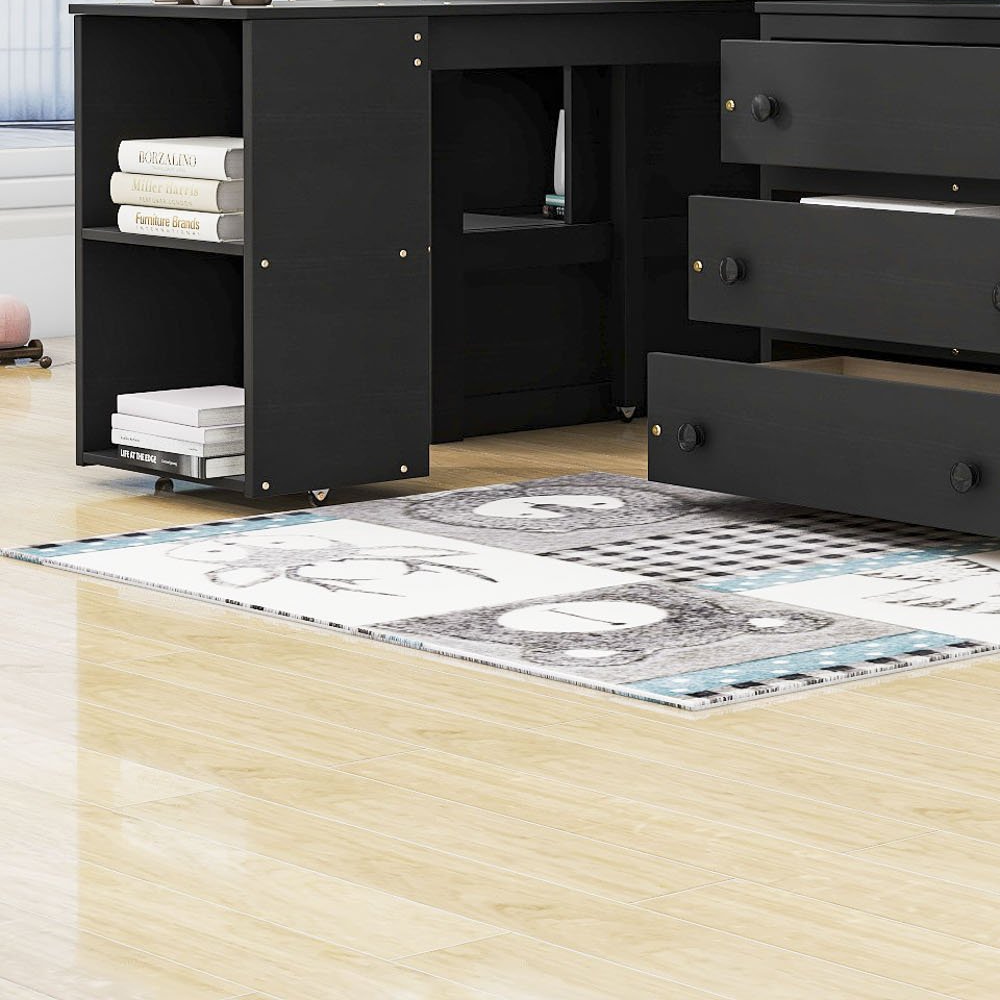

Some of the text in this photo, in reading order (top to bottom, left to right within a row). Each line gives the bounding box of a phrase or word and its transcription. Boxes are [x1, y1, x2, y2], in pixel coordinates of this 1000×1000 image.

[138, 150, 197, 168] BORZALINO
[131, 179, 199, 197] Miller Harris
[135, 211, 200, 230] Furniture Brands
[120, 448, 130, 459] LIFE
[129, 450, 135, 459] AT
[136, 451, 145, 461] THE
[144, 453, 157, 464] EDGE
